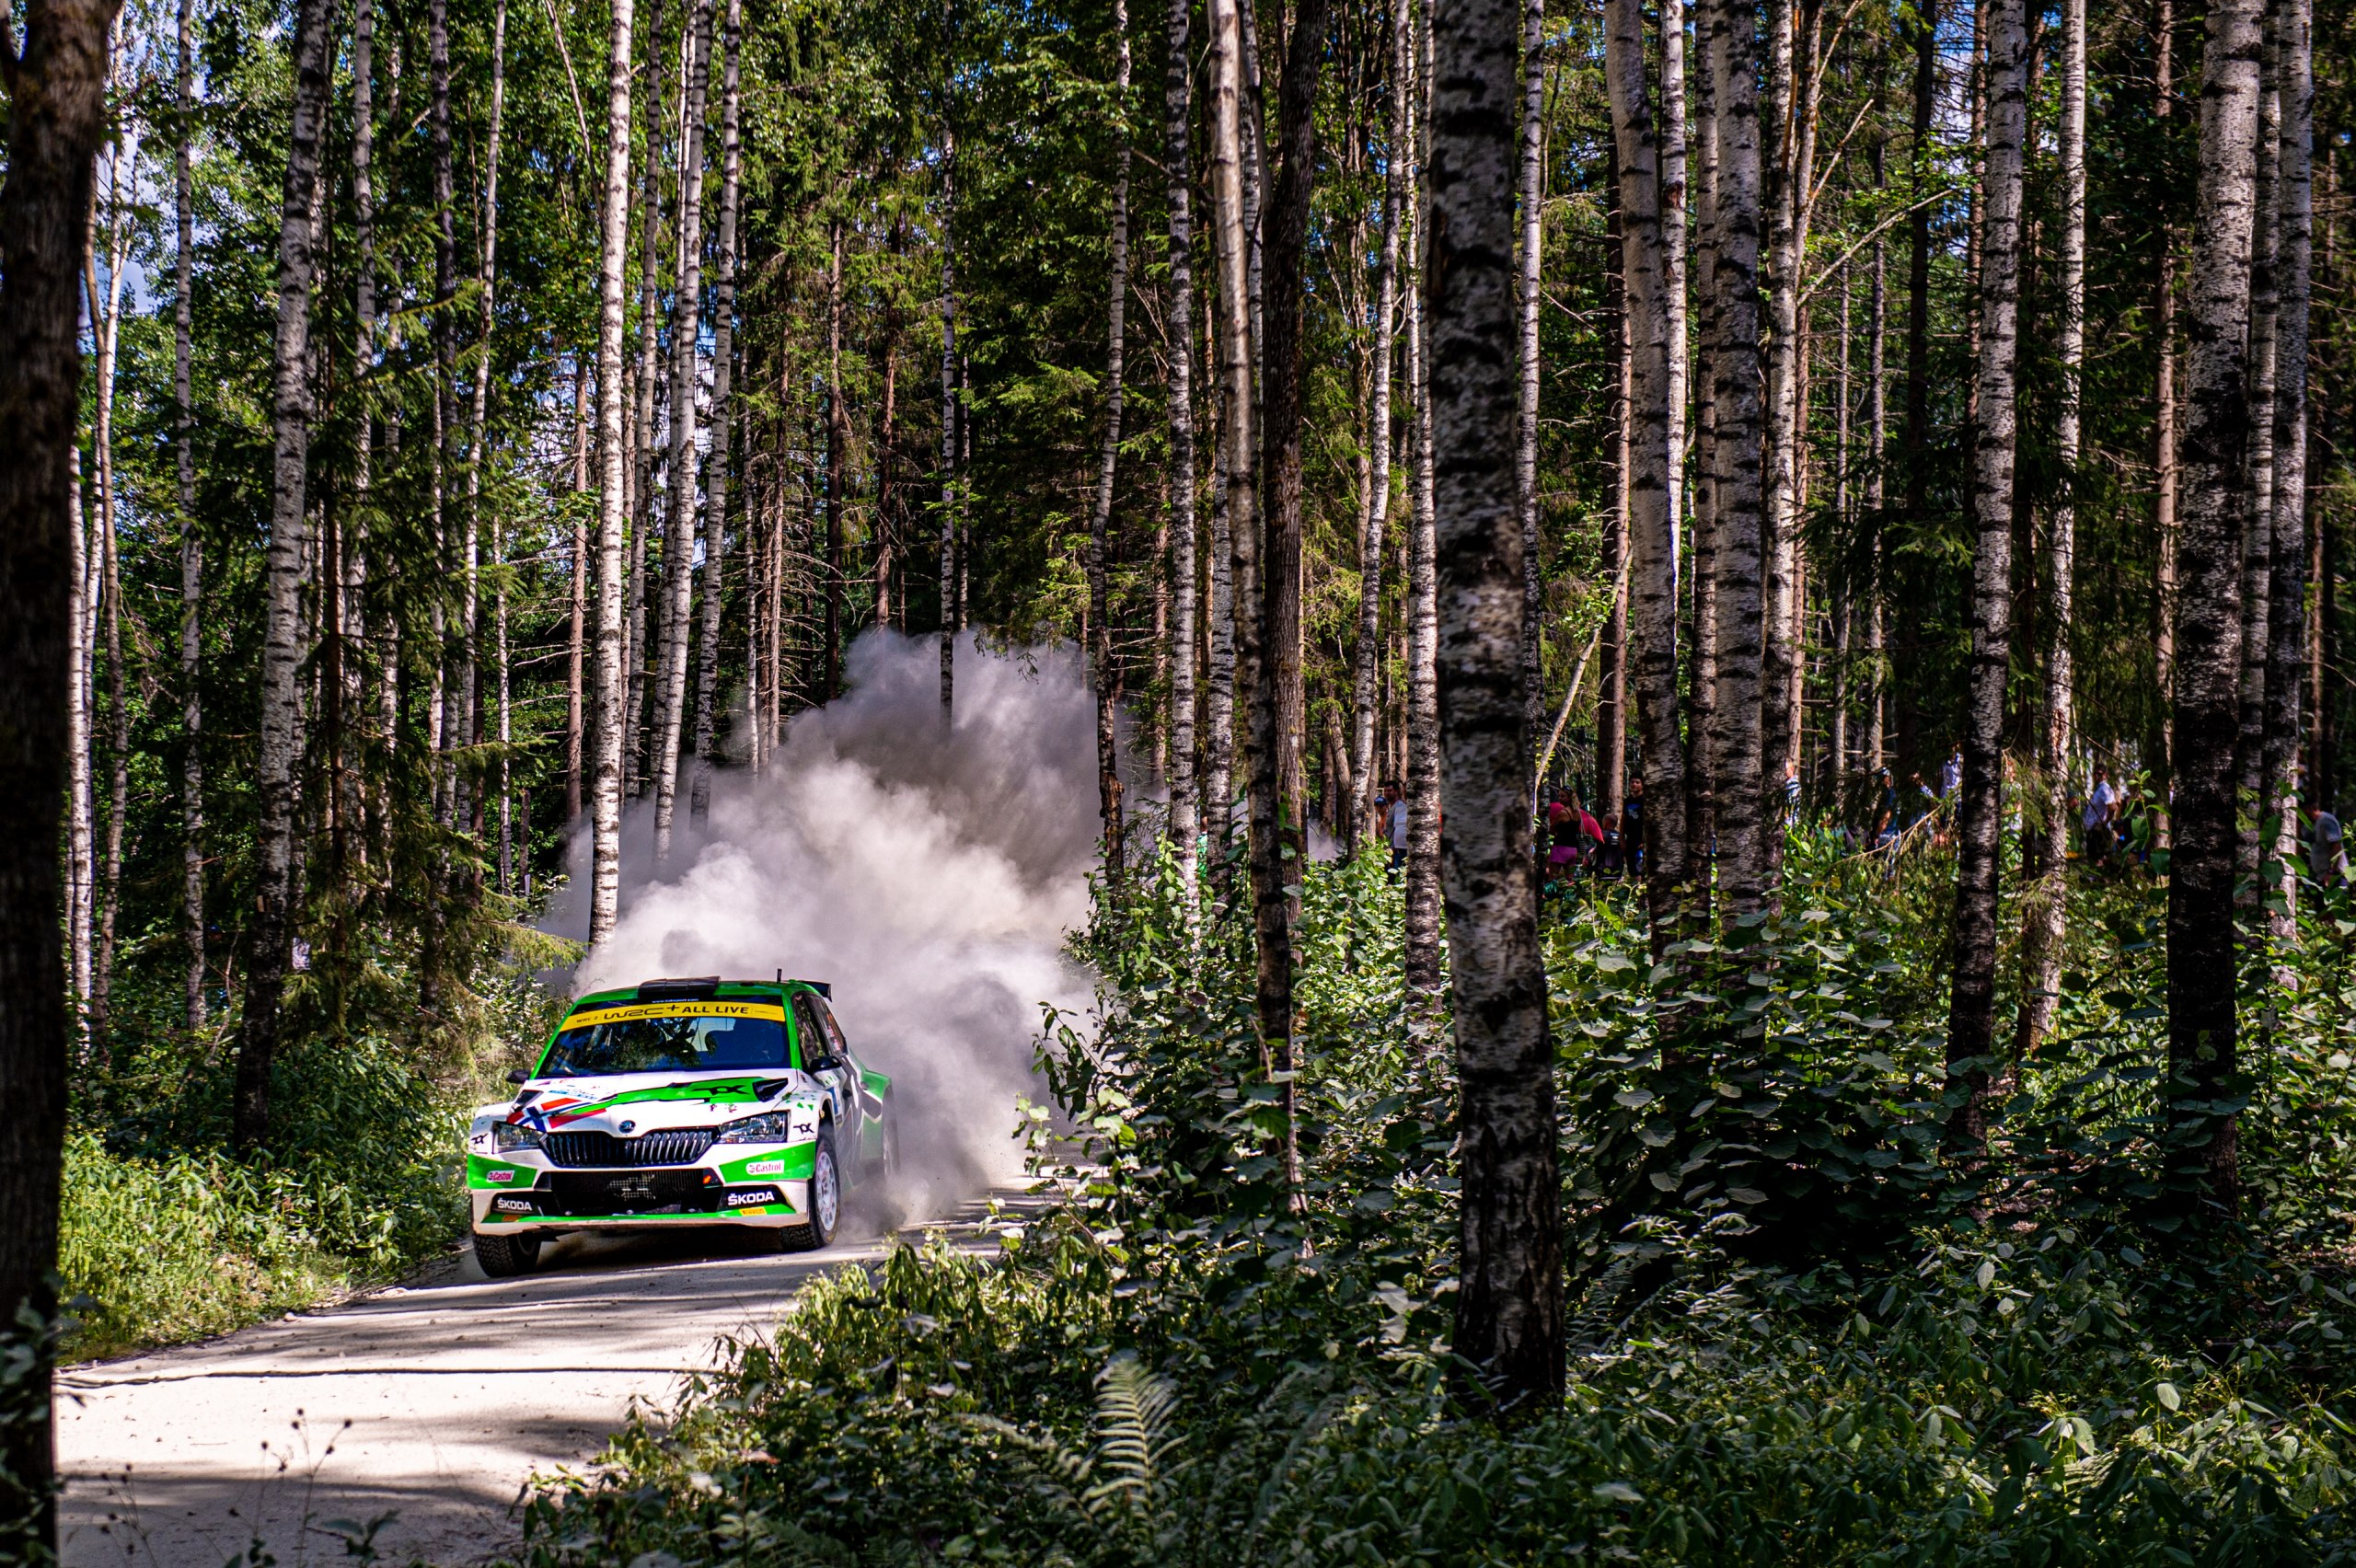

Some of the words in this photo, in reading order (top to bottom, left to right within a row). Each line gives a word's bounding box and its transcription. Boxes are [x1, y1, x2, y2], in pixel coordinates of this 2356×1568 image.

[682, 1006, 710, 1014] ALL
[715, 1006, 749, 1015] LIVE
[755, 1162, 781, 1173] Castrol
[492, 1171, 513, 1182] Castrol
[497, 1197, 533, 1211] ŠKODA
[727, 1191, 775, 1206] ŠKODA
